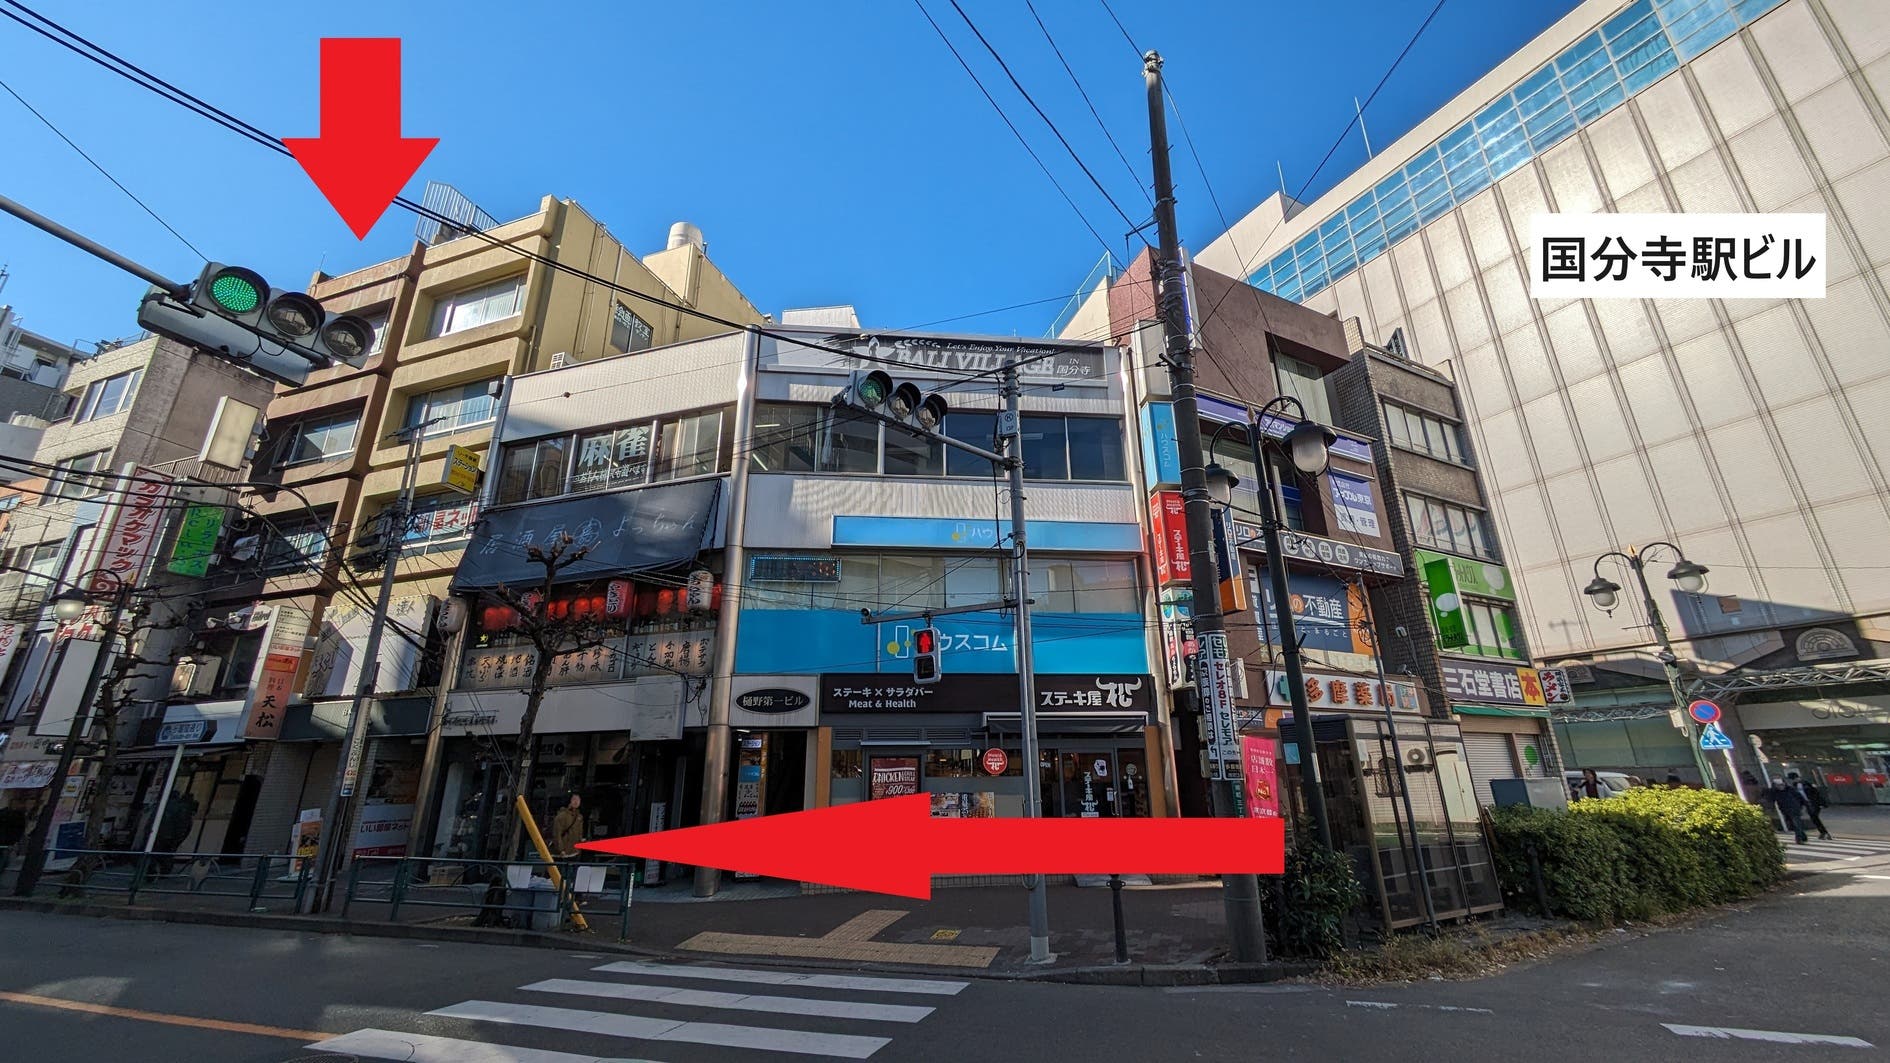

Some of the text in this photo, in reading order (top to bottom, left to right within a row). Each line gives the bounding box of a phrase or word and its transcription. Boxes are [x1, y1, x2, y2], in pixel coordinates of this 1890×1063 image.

[894, 345, 952, 370] BALI
[947, 342, 1055, 354] Let's Enjoy Your Vacation!
[1057, 364, 1092, 375] 国分寺
[578, 426, 650, 468] 麻雀
[1265, 588, 1344, 618] リの不動産
[937, 634, 1008, 652] ウスコム
[833, 688, 872, 698] ステーキ
[886, 687, 934, 698] サラダバー
[1214, 661, 1226, 709] セレオ8F
[1304, 677, 1395, 707] 多摩薬局
[1447, 667, 1523, 700] 三石堂書店
[742, 695, 804, 707] 樋野第一ビル
[848, 699, 916, 709] Meat & Health
[1040, 690, 1101, 706] ステーキ屋
[1219, 710, 1233, 746] セレモア
